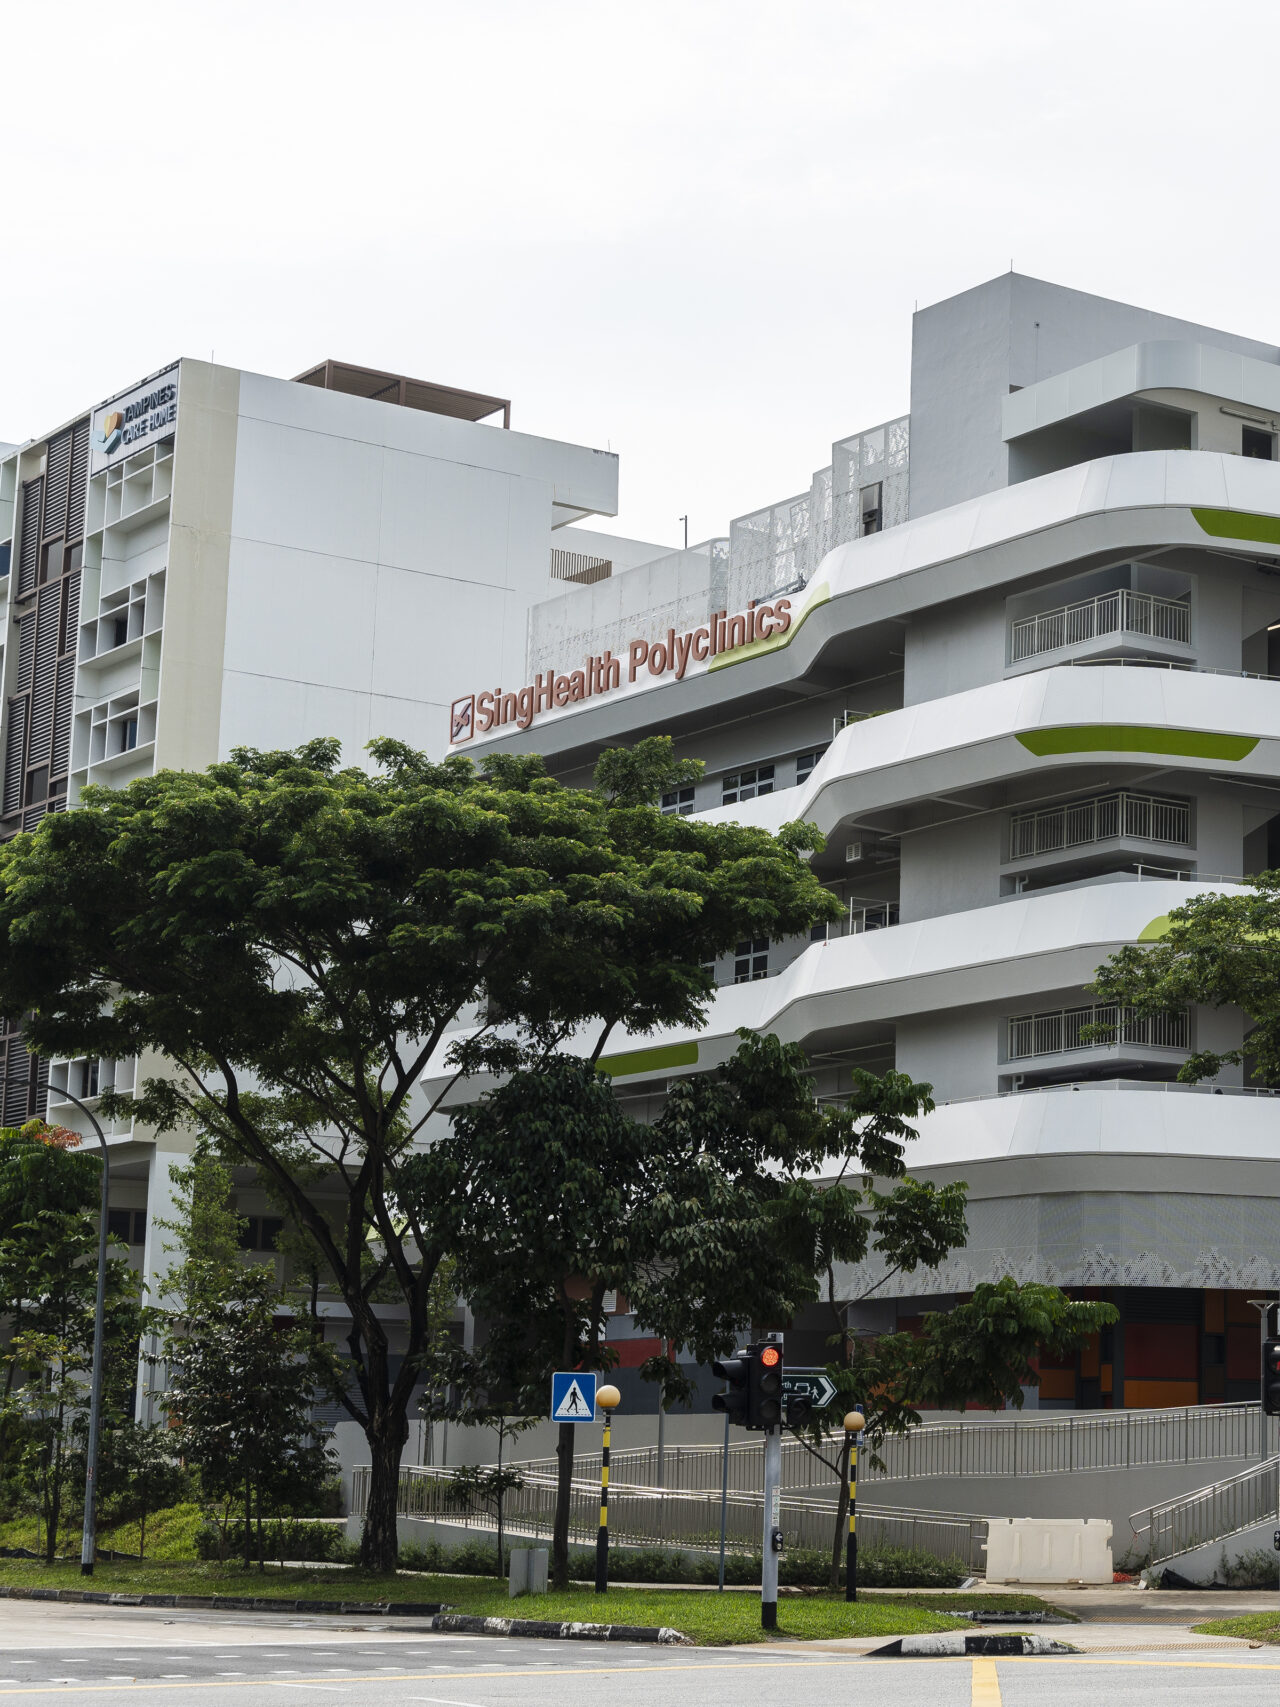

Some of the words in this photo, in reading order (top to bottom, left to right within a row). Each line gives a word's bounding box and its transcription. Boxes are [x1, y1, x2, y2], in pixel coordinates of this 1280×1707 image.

[123, 383, 176, 423] TAMPINES
[121, 419, 148, 445] CARE
[149, 404, 176, 431] HOME
[476, 650, 620, 729] SingHealth
[629, 599, 791, 682] Polyclinics
